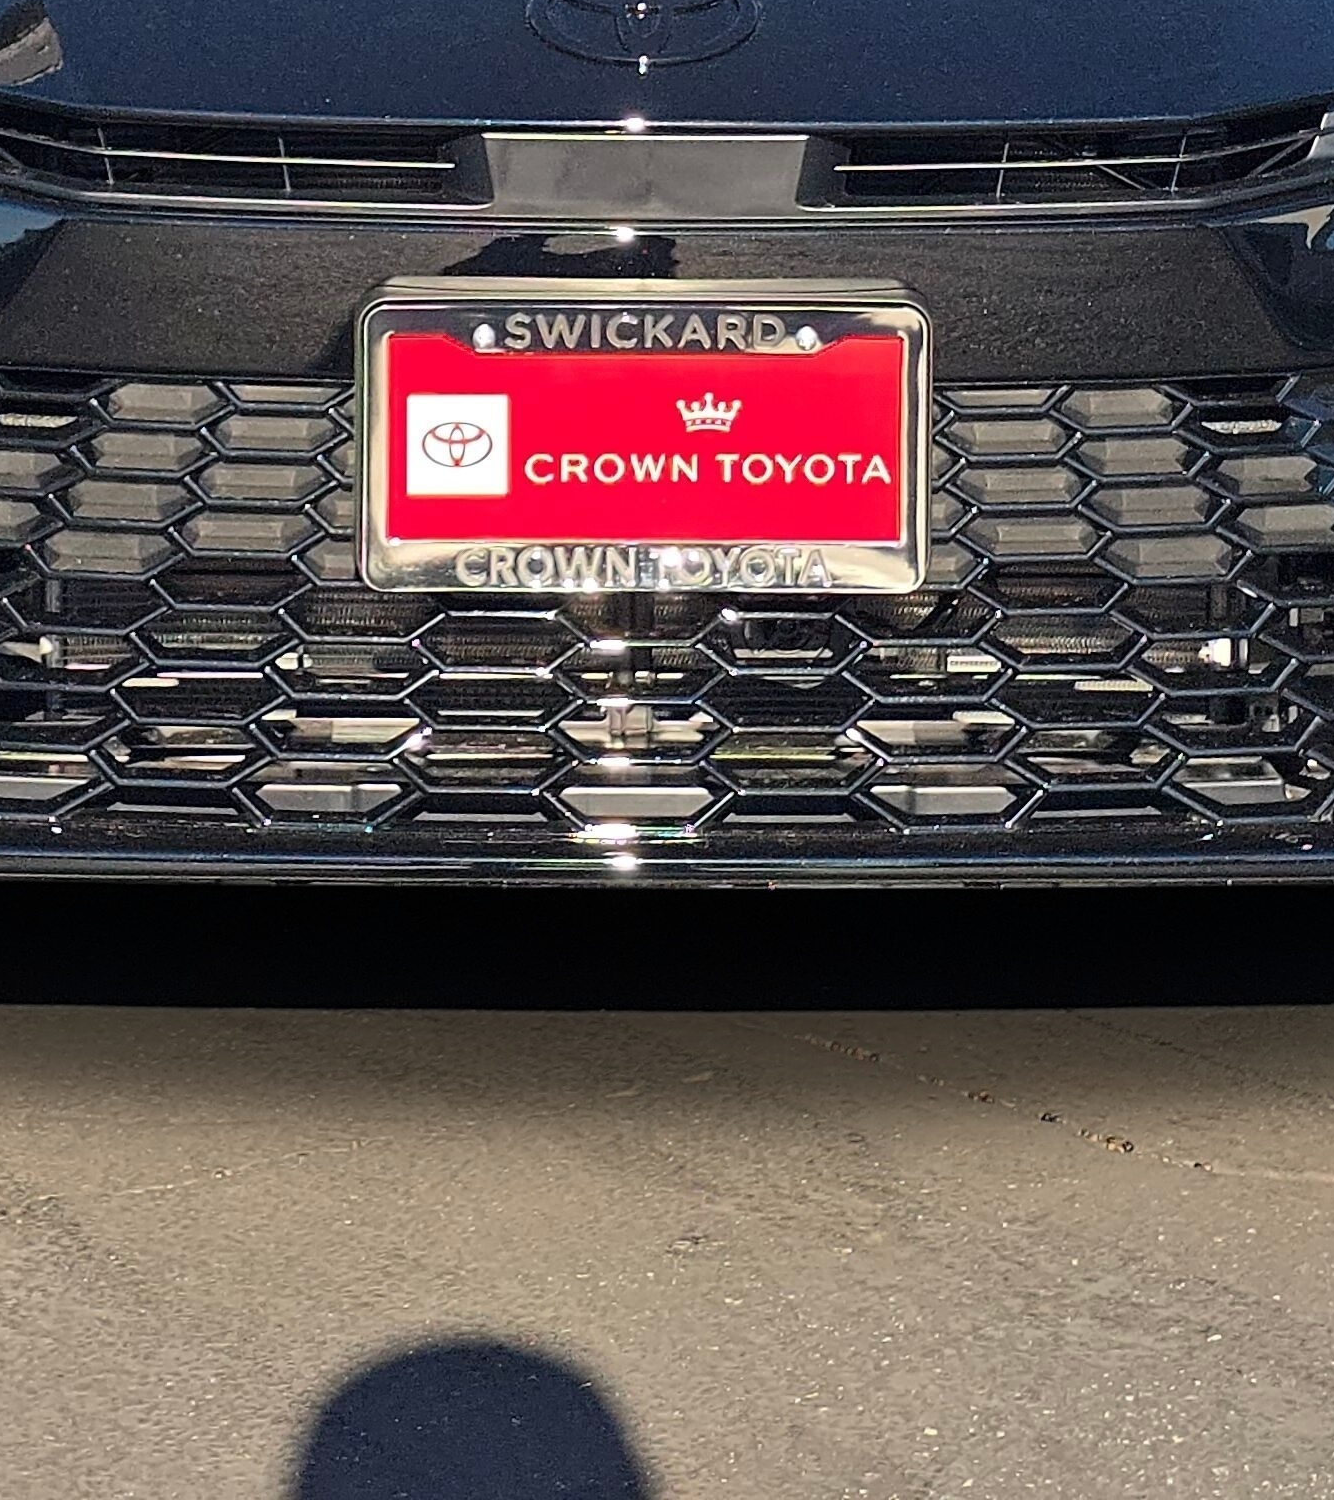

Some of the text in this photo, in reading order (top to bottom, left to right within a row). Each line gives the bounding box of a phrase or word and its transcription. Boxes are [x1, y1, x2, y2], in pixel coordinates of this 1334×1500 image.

[504, 312, 786, 349] SWICKARD
[524, 453, 892, 484] CROWN TOYOTA
[455, 546, 636, 587] CROWN
